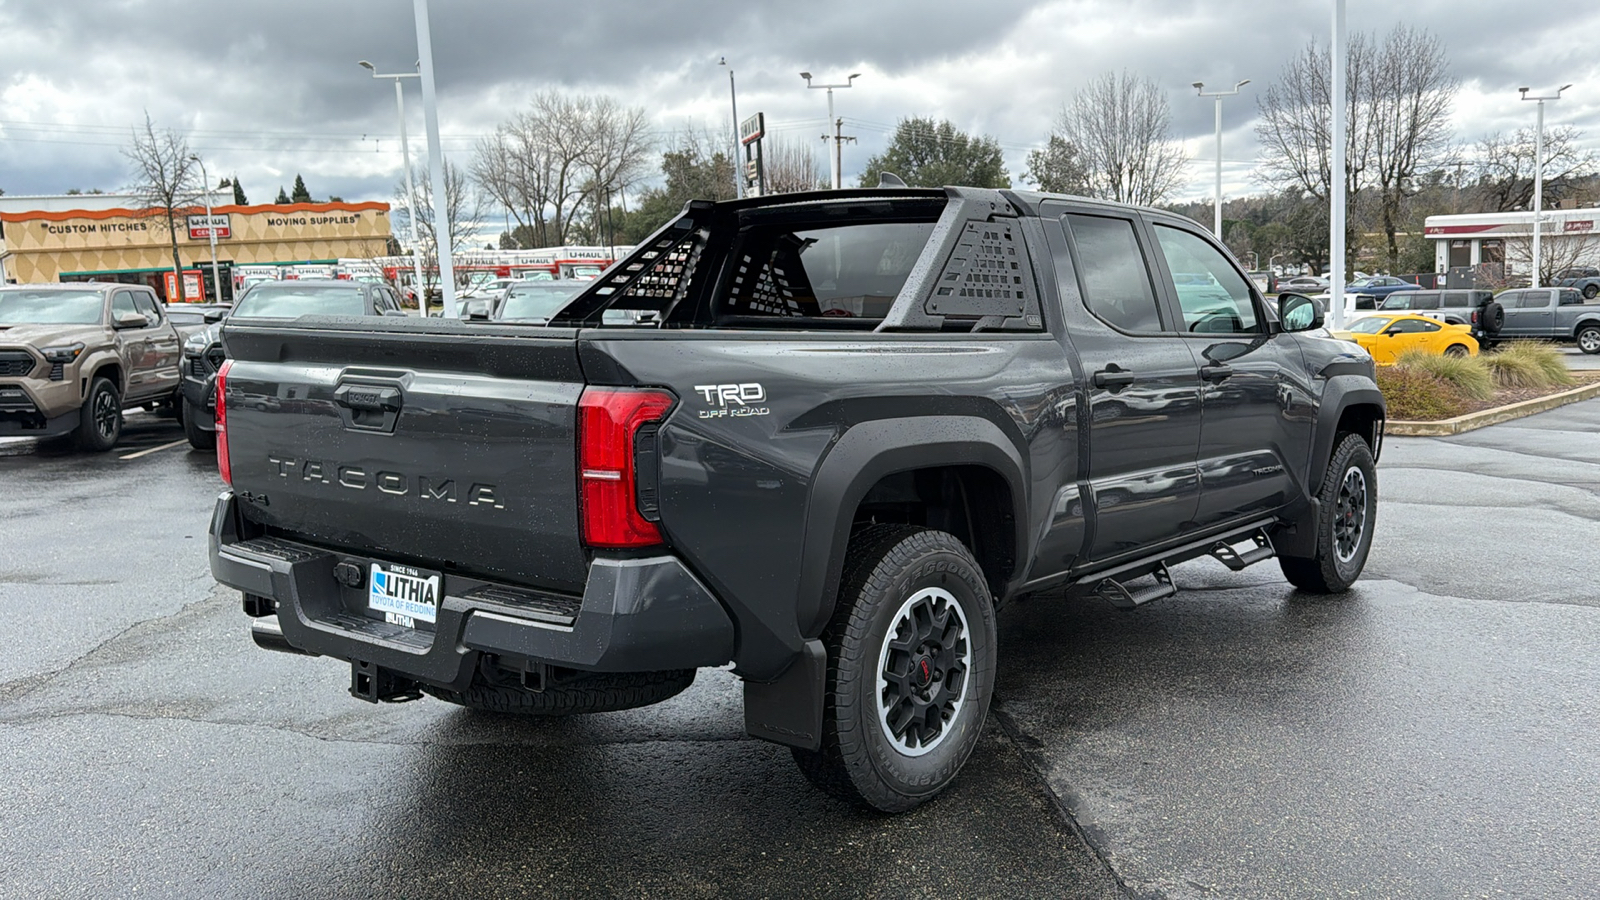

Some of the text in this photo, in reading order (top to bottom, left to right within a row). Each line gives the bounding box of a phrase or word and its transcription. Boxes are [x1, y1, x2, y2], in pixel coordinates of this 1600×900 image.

[268, 217, 306, 226] MOVING
[48, 223, 147, 234] CUSTOM HITCHES
[350, 392, 378, 404] TOYOTA
[694, 383, 766, 406] TRD
[698, 407, 770, 418] OFF ROAD
[268, 454, 504, 509] TACOMA
[390, 564, 418, 577] SINCE 1946
[386, 574, 436, 606] LITHIA
[372, 594, 436, 617] TOYOTA OF REDDING
